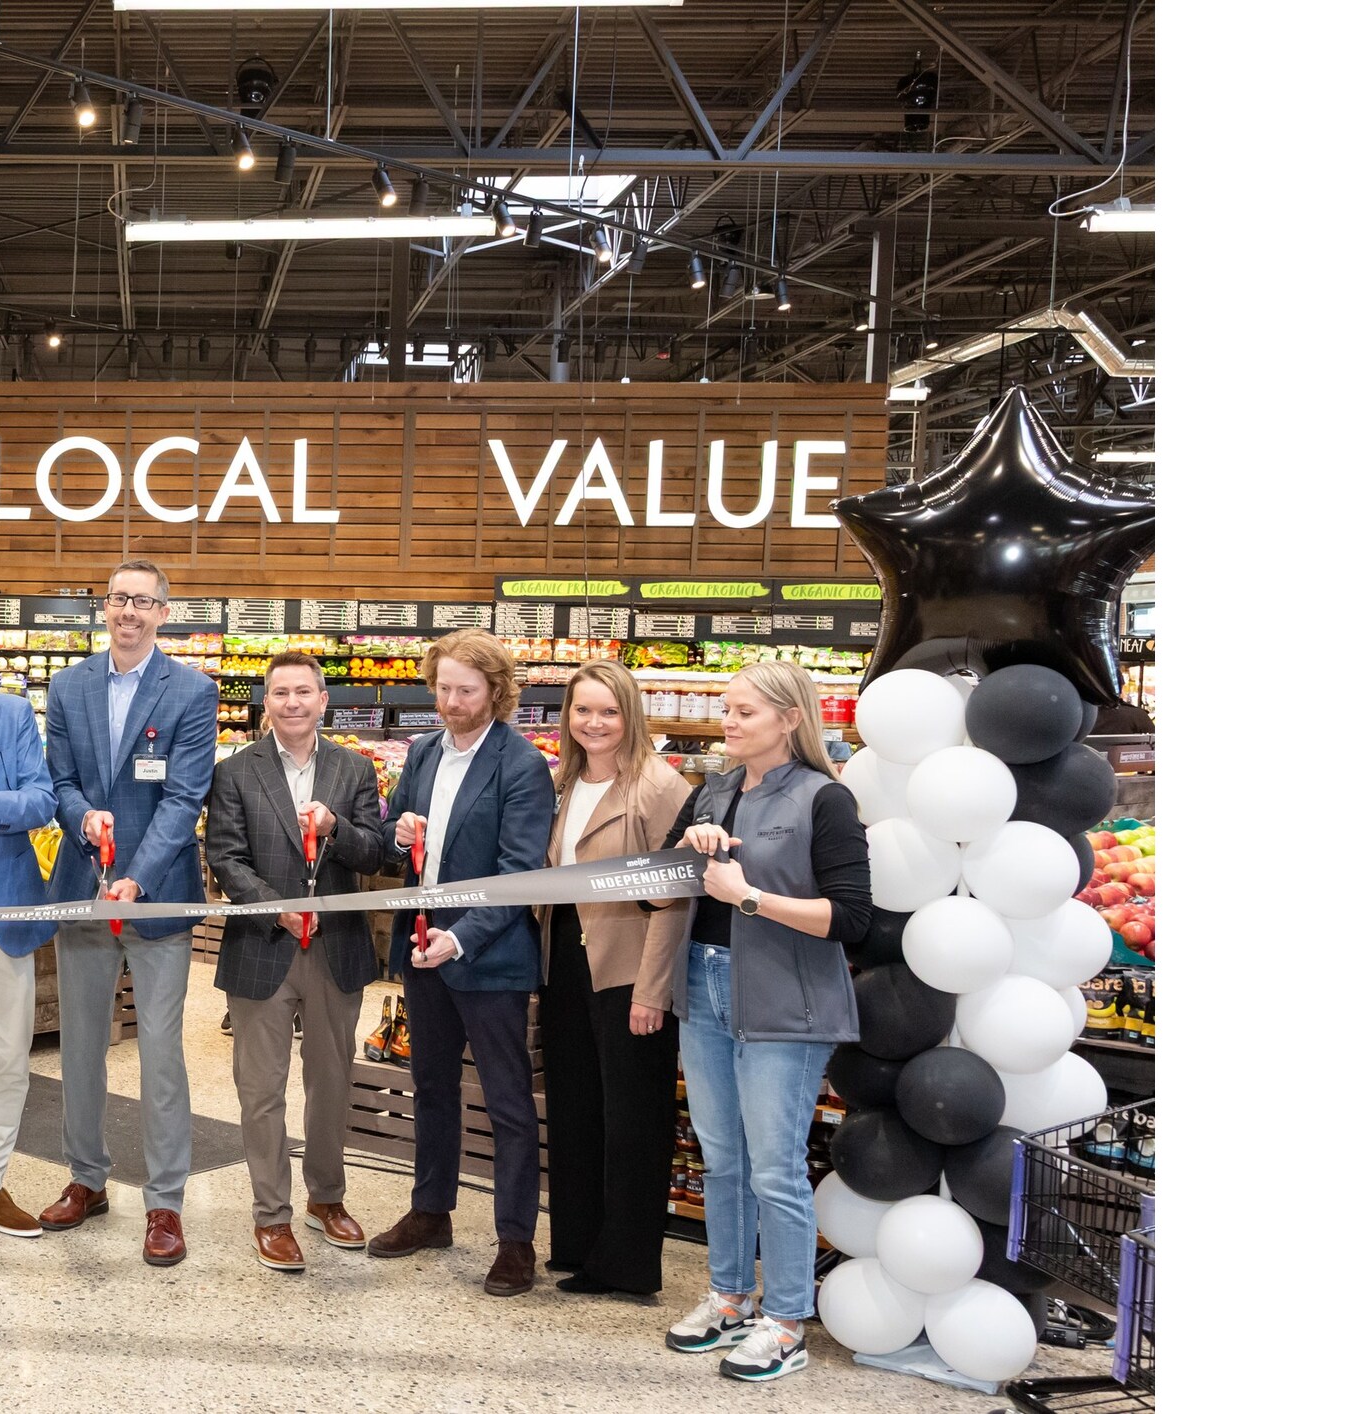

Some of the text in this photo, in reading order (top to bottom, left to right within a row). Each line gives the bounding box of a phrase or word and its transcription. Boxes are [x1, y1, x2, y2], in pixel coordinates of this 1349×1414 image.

[487, 436, 847, 529] VALUE
[511, 582, 619, 595] ORGANIC PRODUCE
[649, 583, 758, 597] ORGANIC PRODUCE
[791, 586, 843, 598] ORGANIC
[1120, 638, 1146, 653] MEAT
[626, 857, 650, 868] meijer
[590, 864, 695, 890] INDEPENDENCE
[421, 887, 444, 895] meijer
[626, 885, 668, 897] MARKET
[385, 892, 487, 908] INDEPENDENCE
[185, 907, 284, 915] INDEPENDENCE
